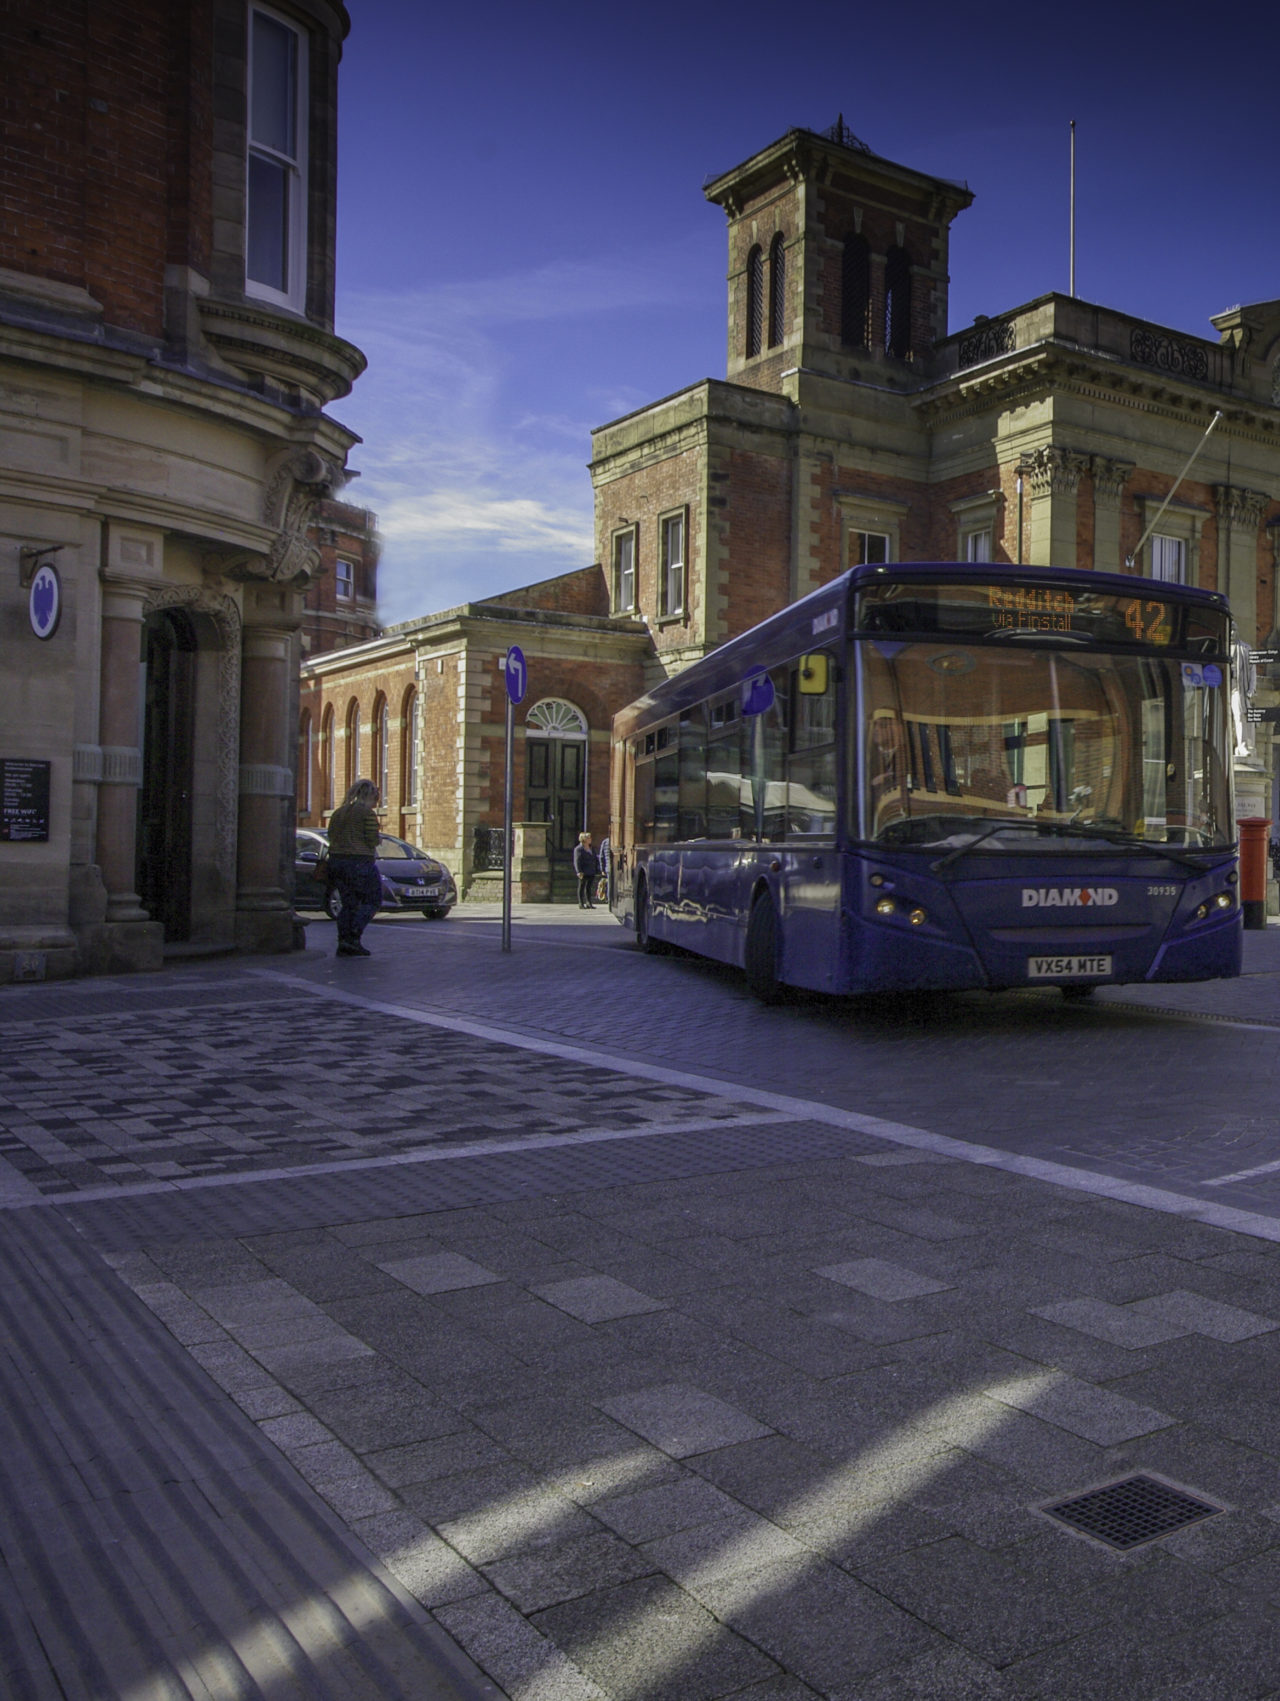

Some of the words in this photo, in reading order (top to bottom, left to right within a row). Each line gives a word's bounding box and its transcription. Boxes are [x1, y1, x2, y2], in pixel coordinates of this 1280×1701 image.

[988, 585, 1075, 613] Redditch
[992, 609, 1014, 629] via
[1018, 611, 1072, 632] Finstall
[1125, 599, 1167, 641] 42
[1147, 886, 1177, 896] 30935
[1035, 958, 1074, 974] VX54
[1077, 957, 1107, 973] MTE
